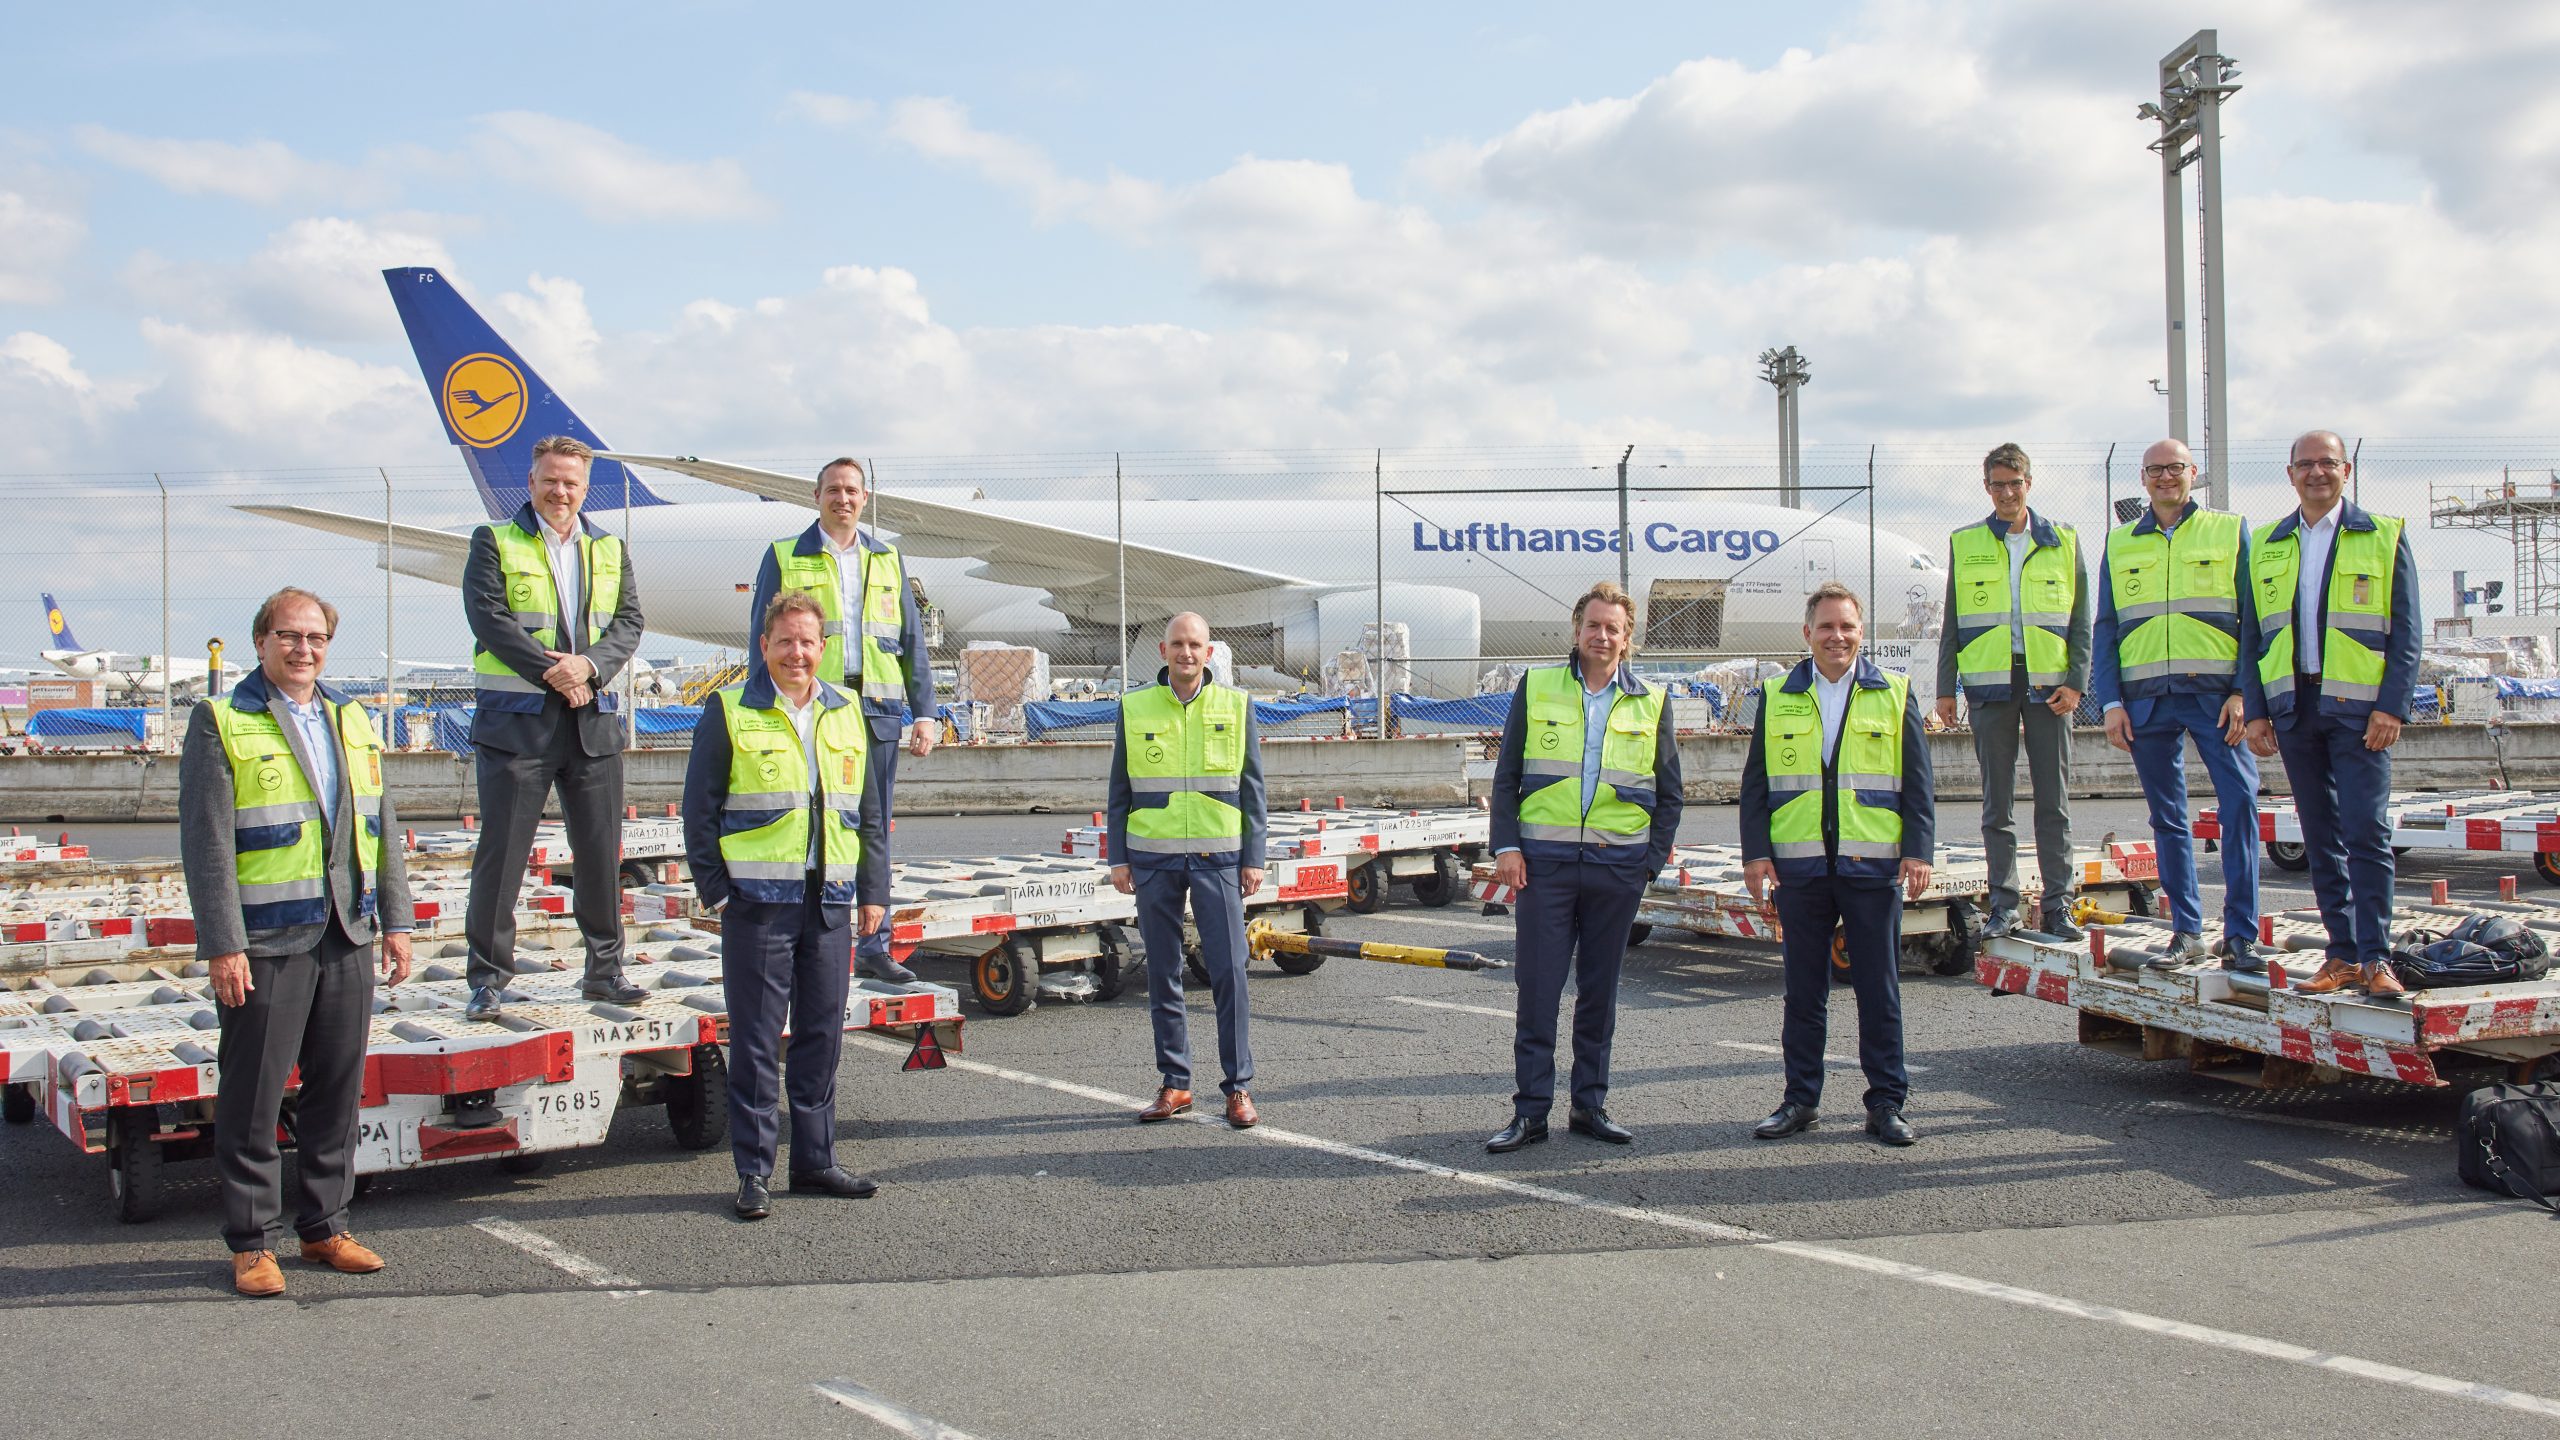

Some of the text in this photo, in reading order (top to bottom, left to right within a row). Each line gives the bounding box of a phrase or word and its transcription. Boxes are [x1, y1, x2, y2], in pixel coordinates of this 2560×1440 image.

[419, 273, 434, 283] FC
[1413, 522, 1780, 561] Lufthansa Cargo
[1381, 823, 1398, 831] TARA
[624, 828, 645, 840] TARA
[1429, 832, 1457, 842] FRAPORT
[624, 843, 666, 856] FRAPORT
[1012, 882, 1095, 900] TARA 1207 KG
[1940, 880, 1984, 894] FRAPORT
[1034, 913, 1057, 926] KPA
[594, 1026, 636, 1044] MAX
[538, 1090, 600, 1115] 7685
